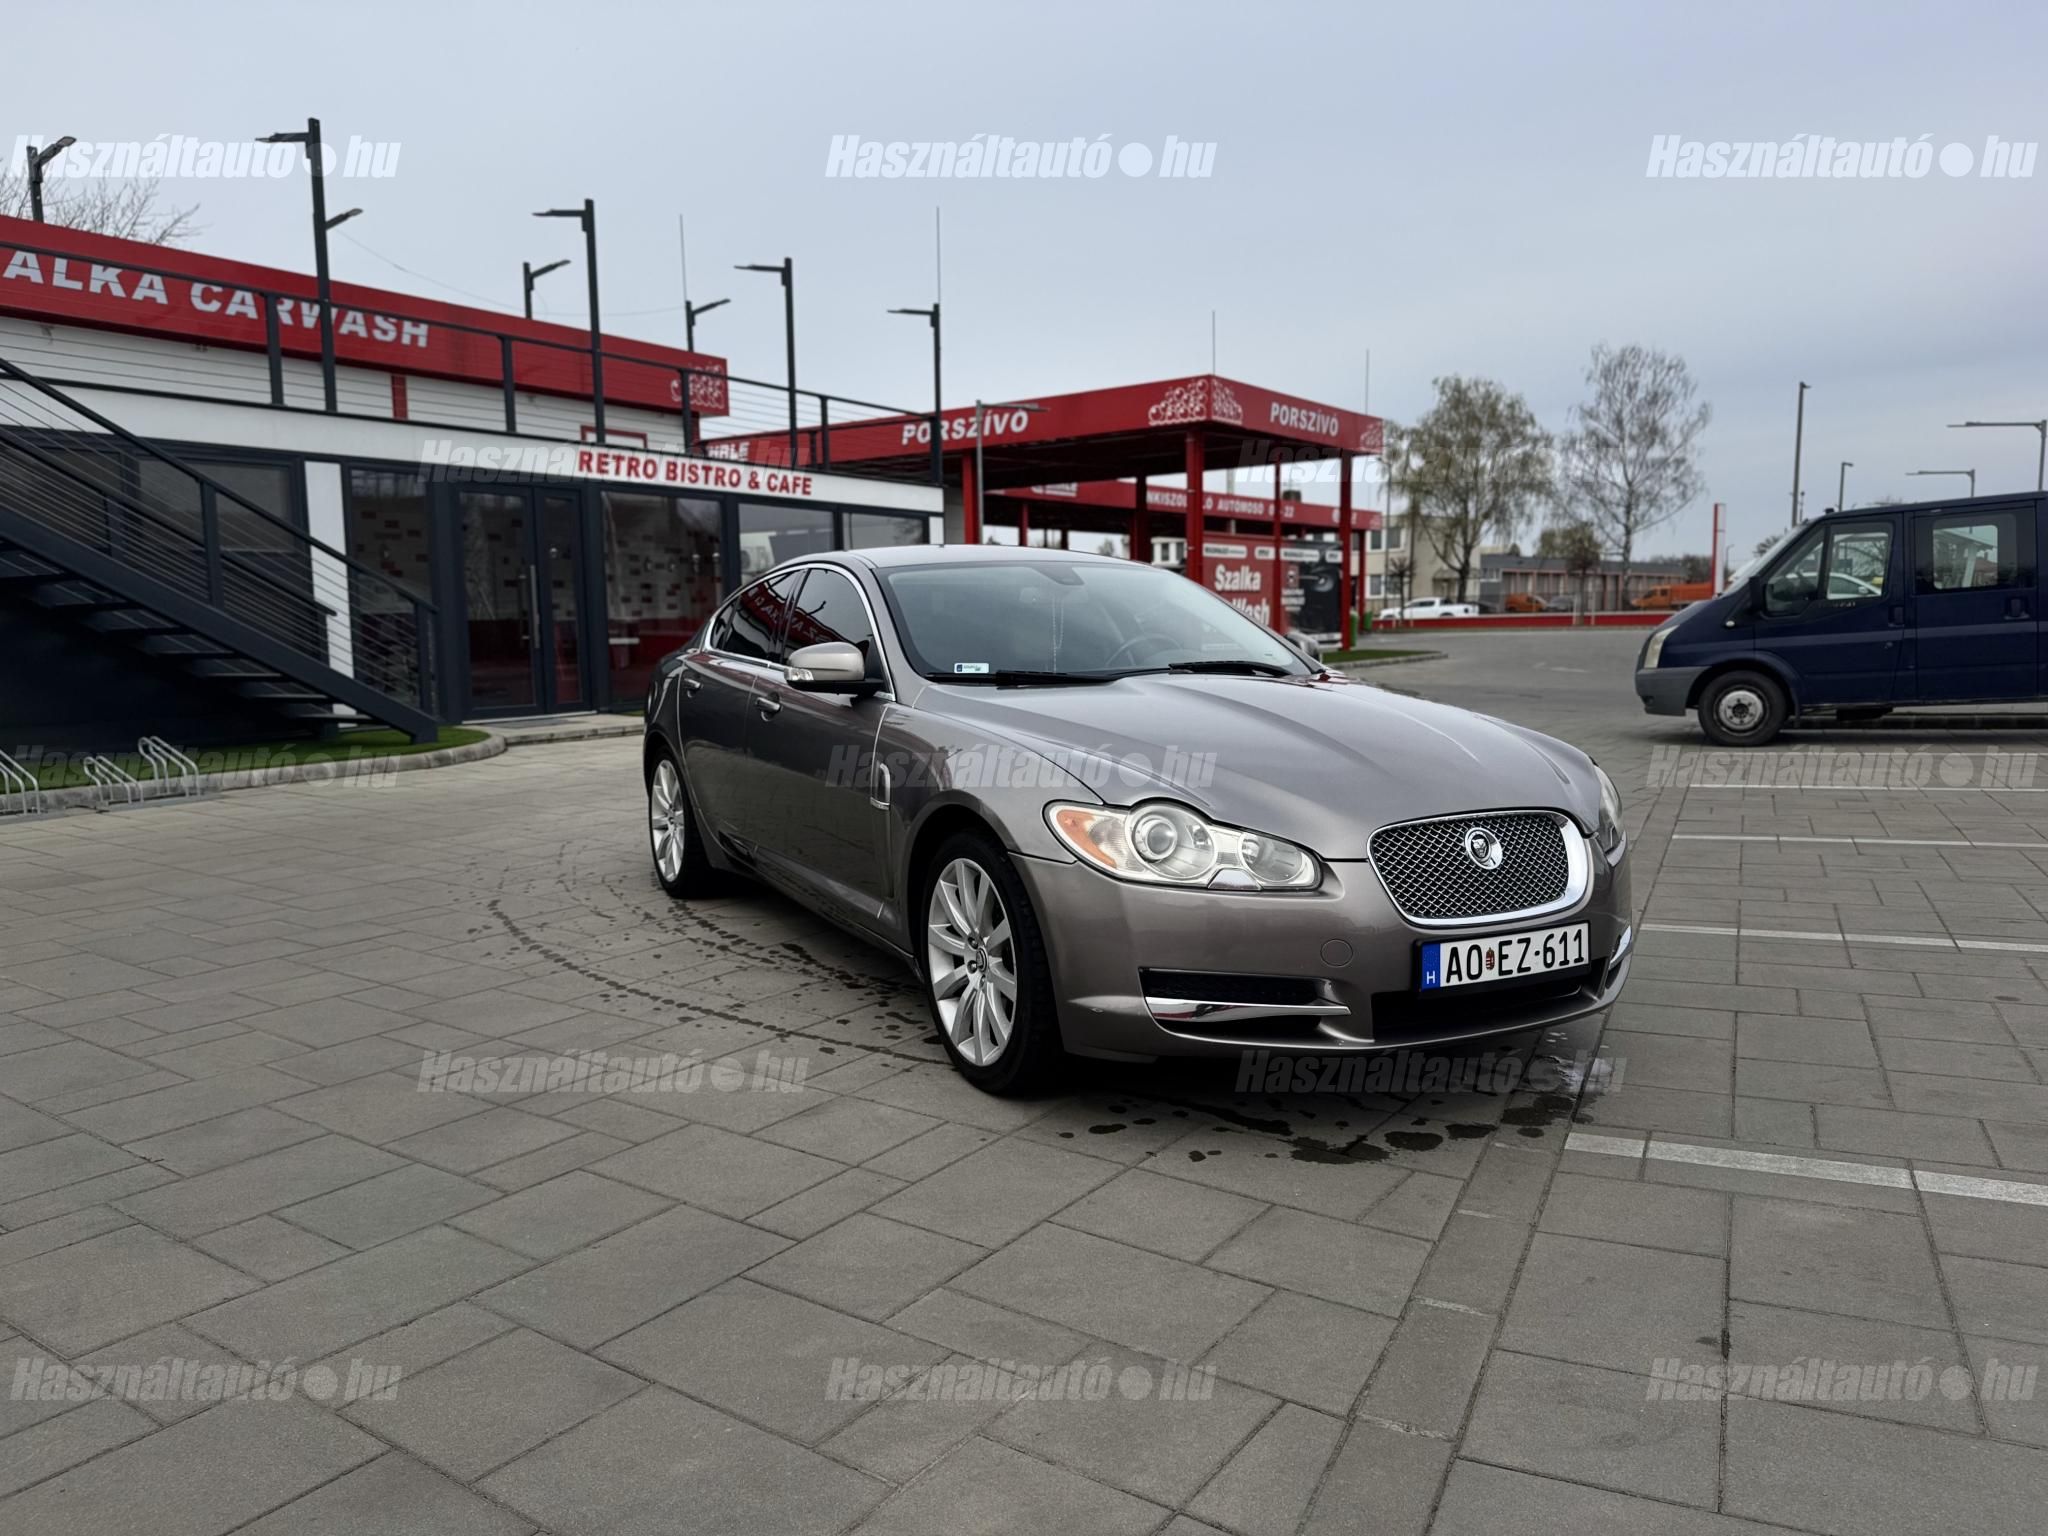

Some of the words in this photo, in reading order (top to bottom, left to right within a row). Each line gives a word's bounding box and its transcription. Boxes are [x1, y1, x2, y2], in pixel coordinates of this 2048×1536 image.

[190, 282, 429, 348] CARWASH
[578, 450, 657, 479] RETRO
[665, 461, 741, 488] BISTRO
[748, 471, 760, 490] &
[767, 473, 812, 496] CAFE
[1214, 563, 1261, 592] Szalka
[1426, 971, 1436, 985] H
[1446, 944, 1483, 984] AO
